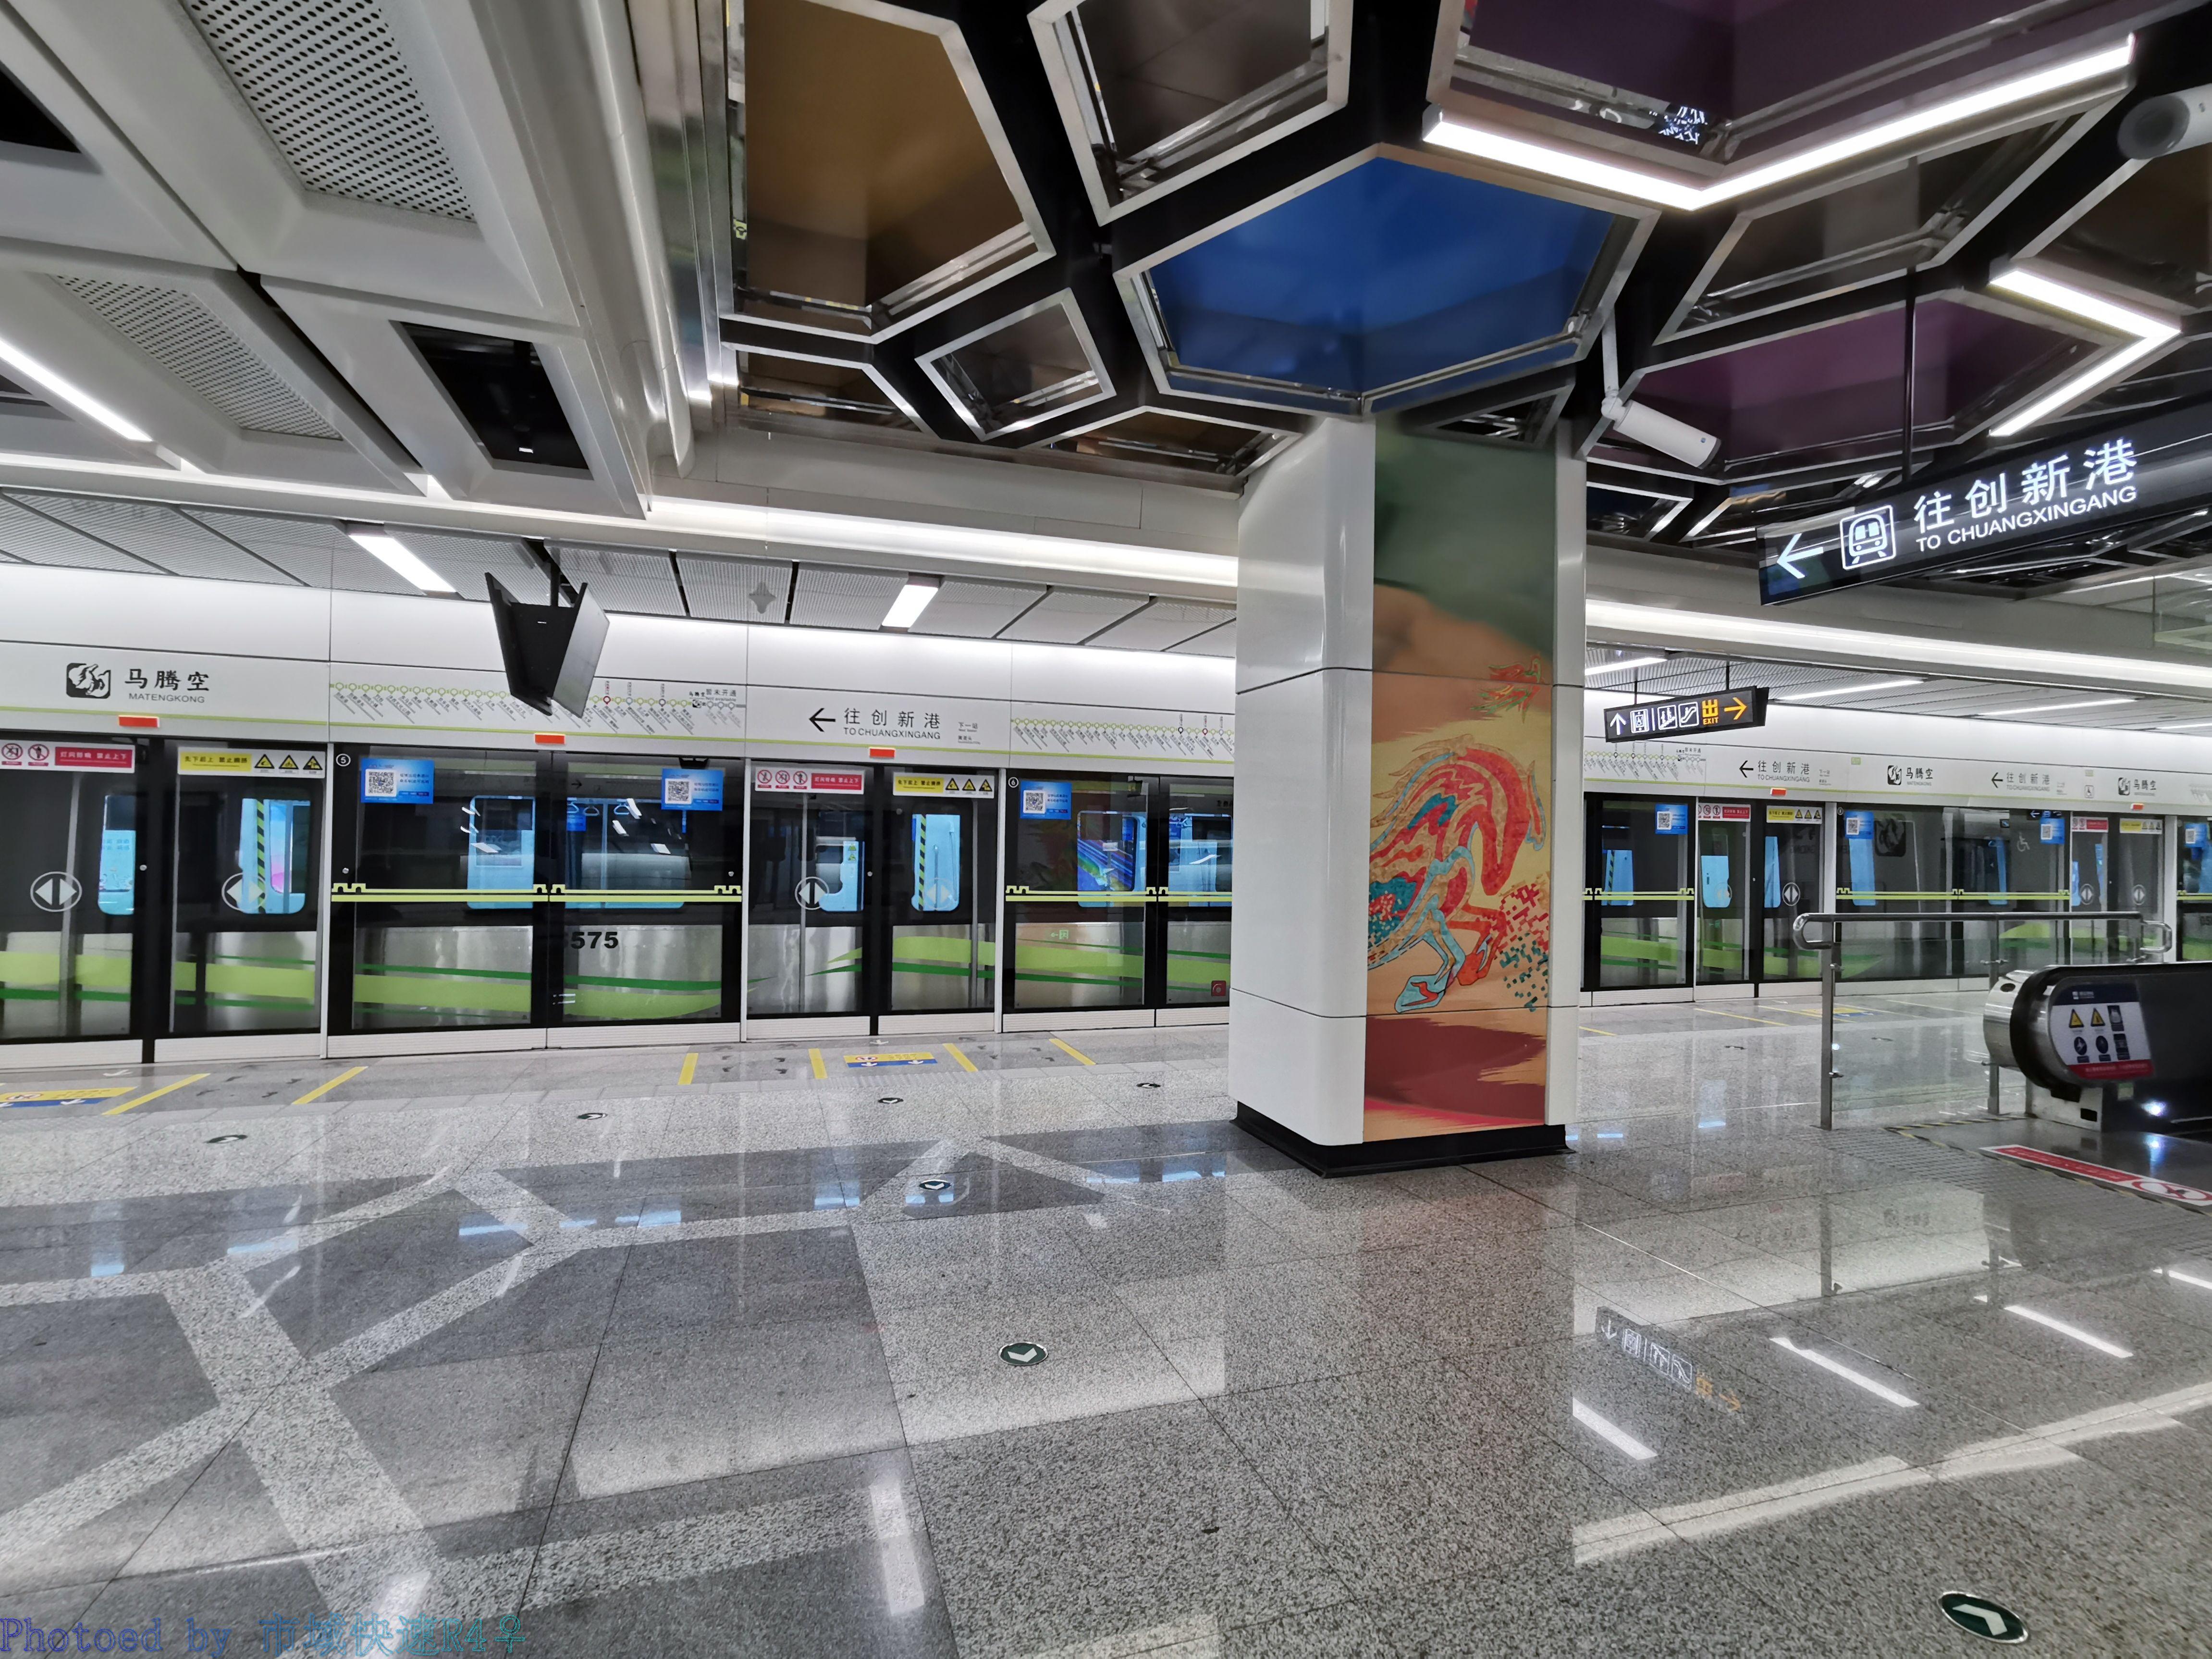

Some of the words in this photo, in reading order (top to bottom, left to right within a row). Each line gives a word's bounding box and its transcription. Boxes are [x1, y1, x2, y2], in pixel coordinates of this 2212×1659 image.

[1914, 436, 2138, 535] 往创新港
[1915, 535, 1941, 553] TO
[1948, 486, 2138, 545] CHUANGXINGANG
[124, 669, 209, 691] 马腾空
[128, 693, 205, 703] MATENGKONG
[1702, 699, 1719, 718] 出
[844, 707, 941, 730] 往创新港
[1703, 718, 1719, 726] EXIT
[844, 727, 857, 735] TO
[858, 728, 941, 740] CHUANGXINGANG
[1758, 760, 1810, 775] 往创新港
[1906, 767, 1933, 780] 马腾空
